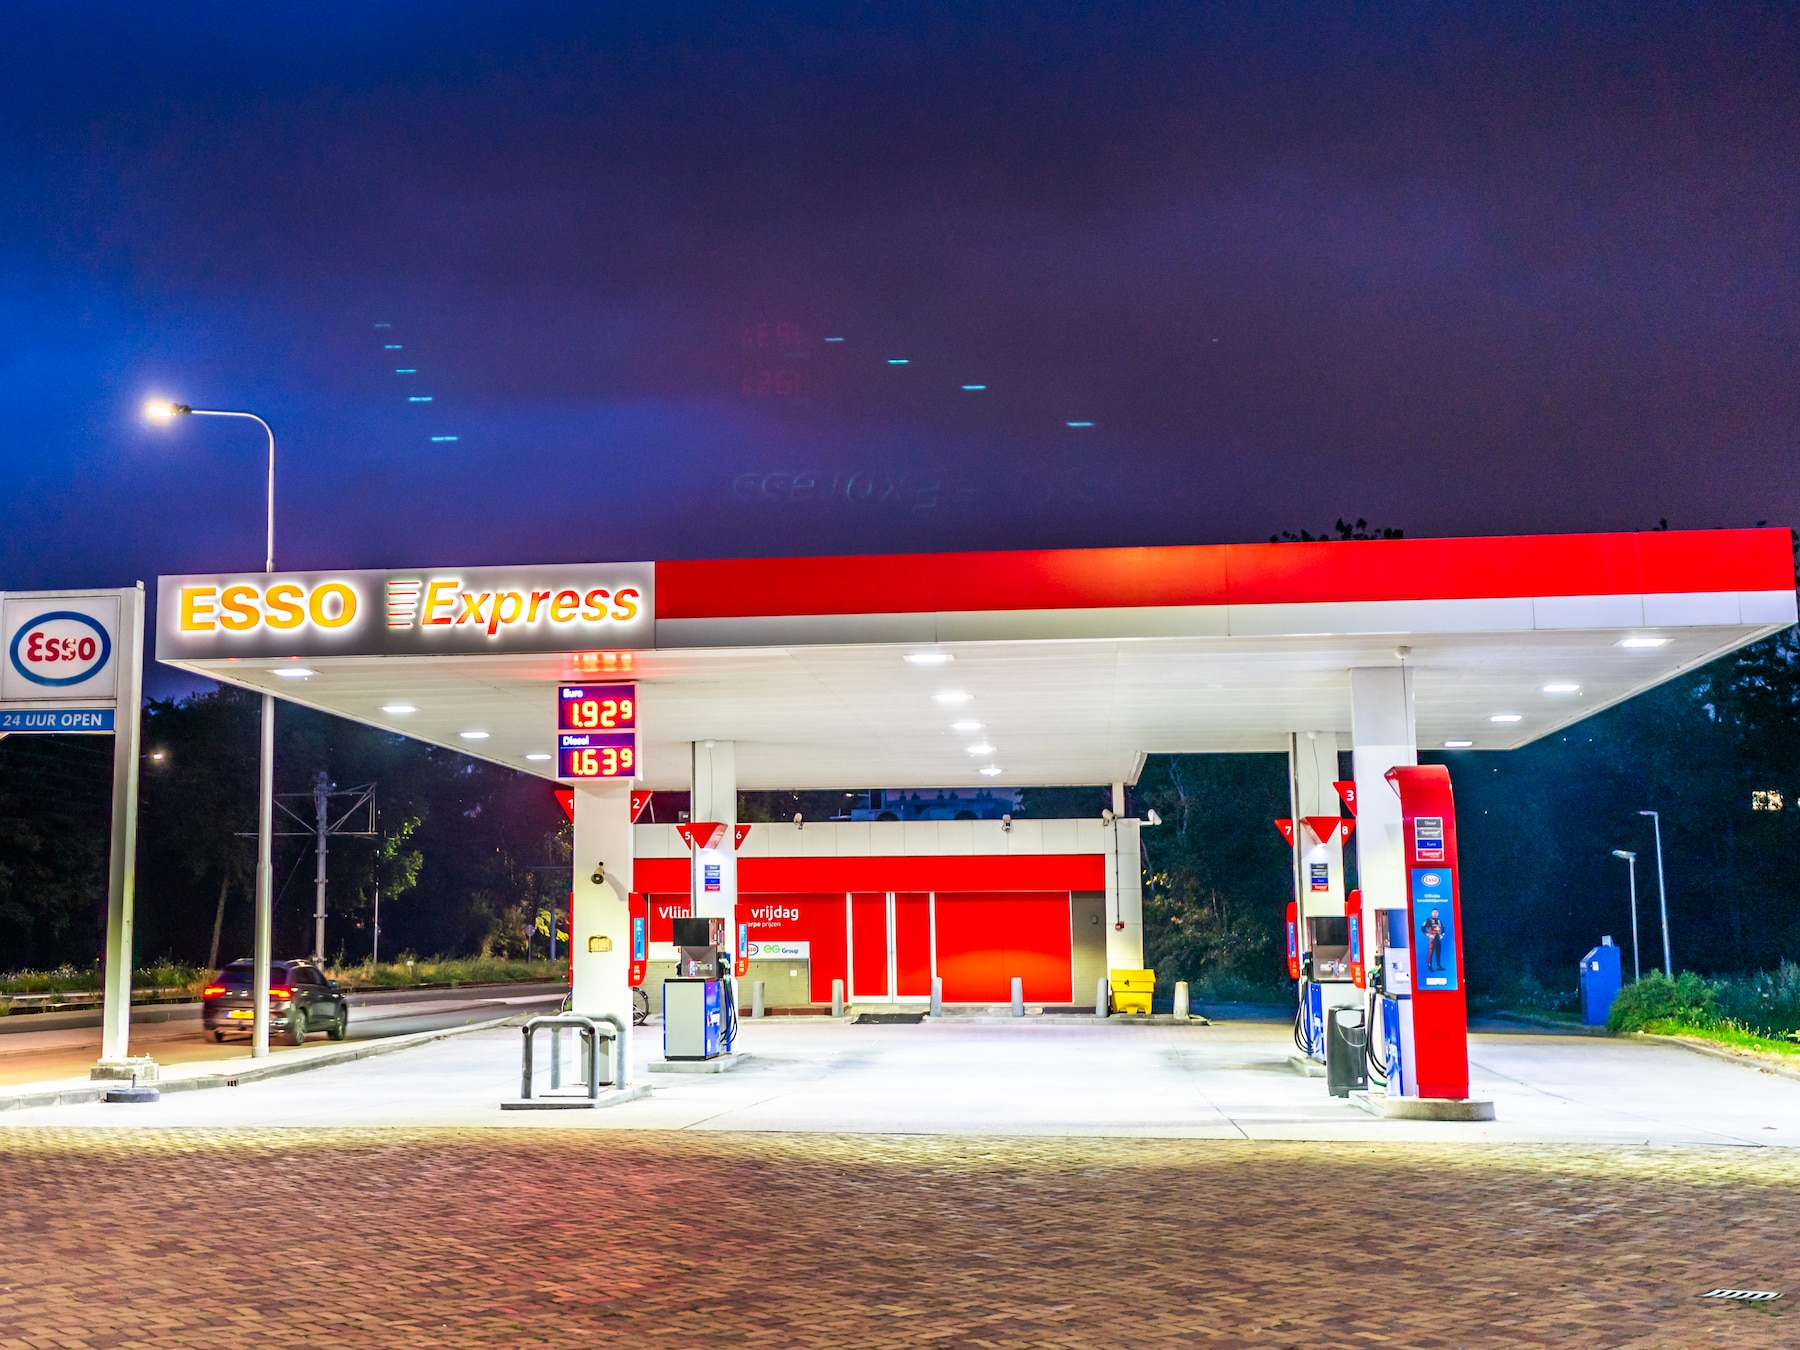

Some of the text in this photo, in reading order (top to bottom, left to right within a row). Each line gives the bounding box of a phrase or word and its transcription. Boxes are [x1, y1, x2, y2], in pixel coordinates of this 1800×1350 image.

[180, 581, 639, 635] ESSO Express
[27, 632, 96, 662] Esso
[563, 688, 584, 698] Euro
[3, 713, 102, 727] 24 UUR OPEN
[562, 735, 589, 746] Diesel
[1346, 790, 1355, 802] 3
[568, 799, 574, 809] 1
[632, 798, 640, 809] 2
[684, 831, 691, 840] 5
[736, 831, 742, 839] 6
[1285, 826, 1292, 835] 7
[1341, 826, 1349, 835] 8
[751, 904, 799, 921] vrijdag
